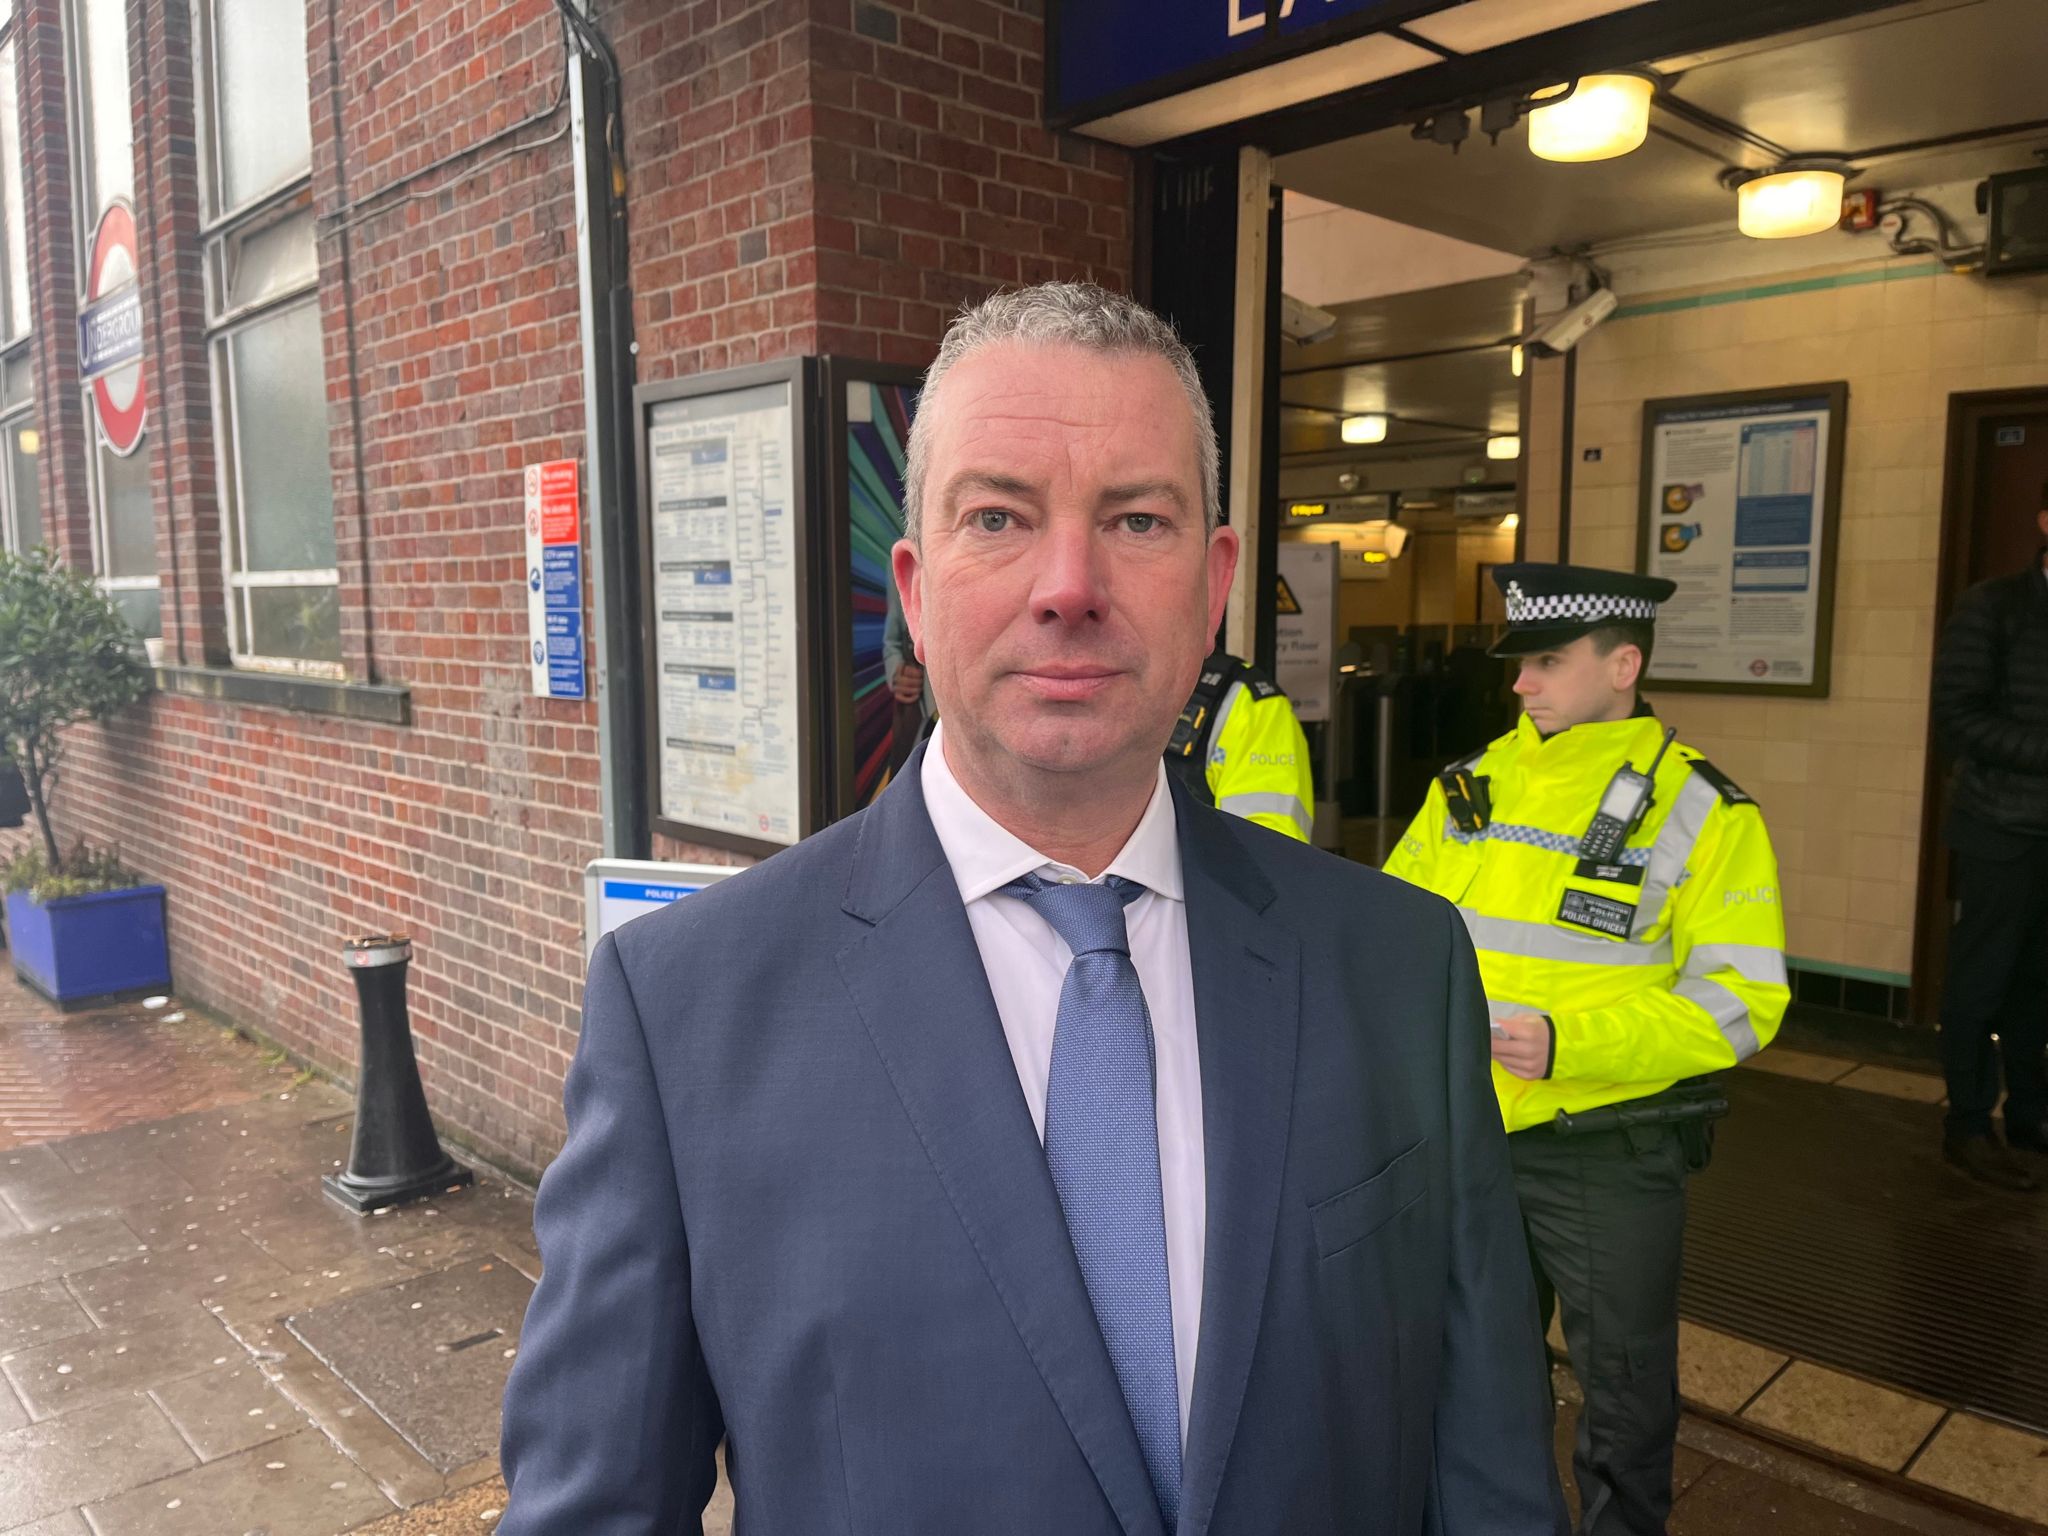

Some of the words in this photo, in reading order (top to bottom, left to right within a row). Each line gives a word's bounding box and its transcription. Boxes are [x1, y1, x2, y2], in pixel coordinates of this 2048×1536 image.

[1249, 751, 1296, 767] POLICE
[645, 888, 675, 900] POLICE
[1589, 906, 1621, 920] POLICE
[1561, 910, 1591, 925] POLICE
[1592, 917, 1627, 935] OFFICER
